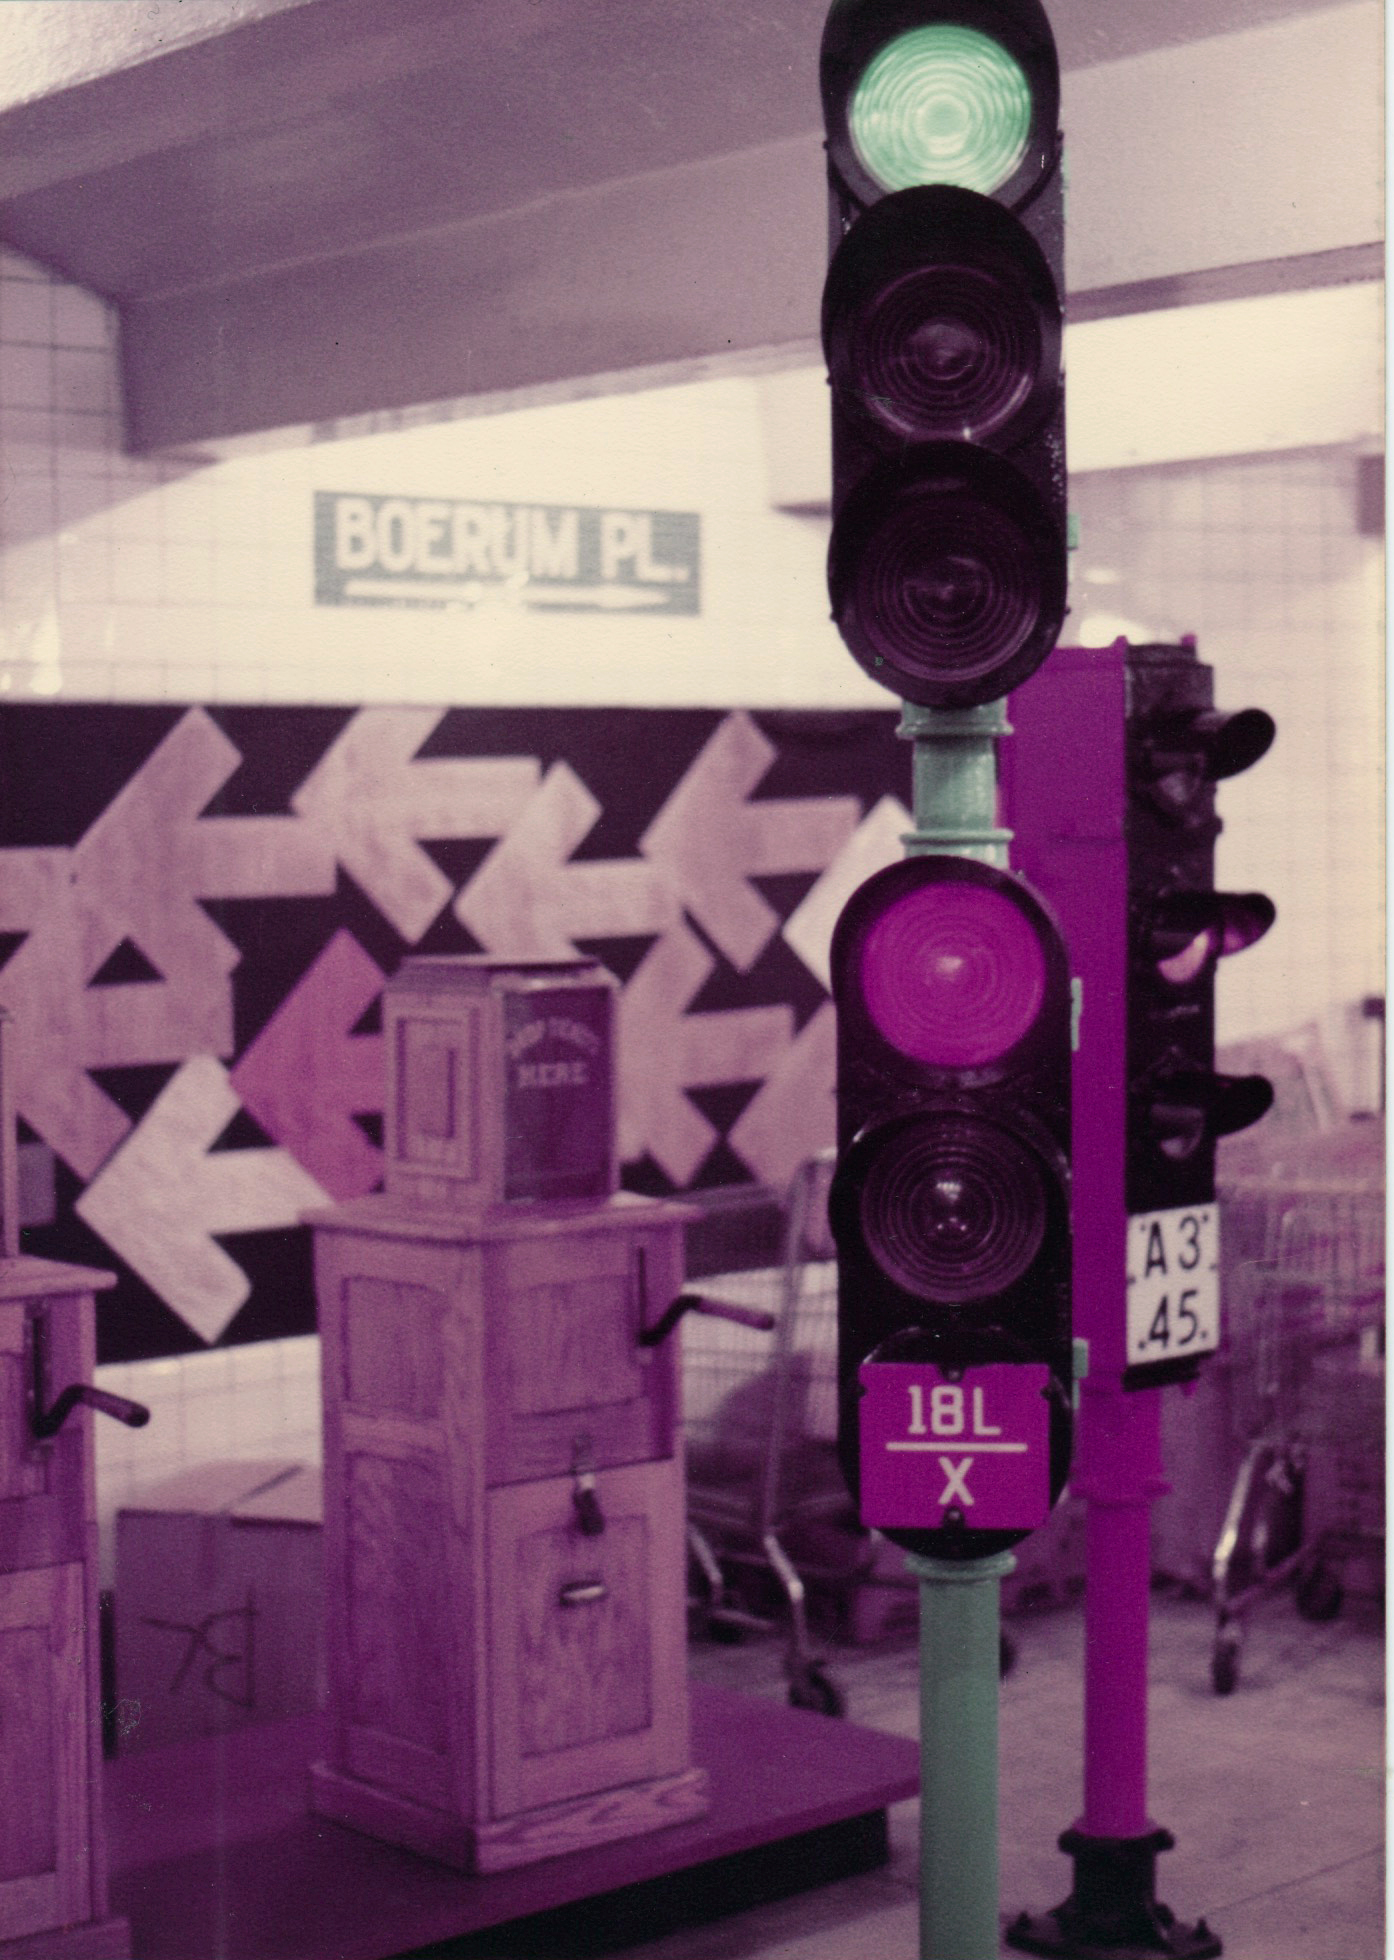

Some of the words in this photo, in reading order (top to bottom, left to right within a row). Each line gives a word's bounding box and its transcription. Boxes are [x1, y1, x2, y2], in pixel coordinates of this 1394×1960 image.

[335, 497, 580, 579] BOERUM
[602, 510, 690, 582] PL.
[1149, 1289, 1198, 1348] 45
[907, 1384, 1002, 1436] 18L
[937, 1456, 976, 1506] X
